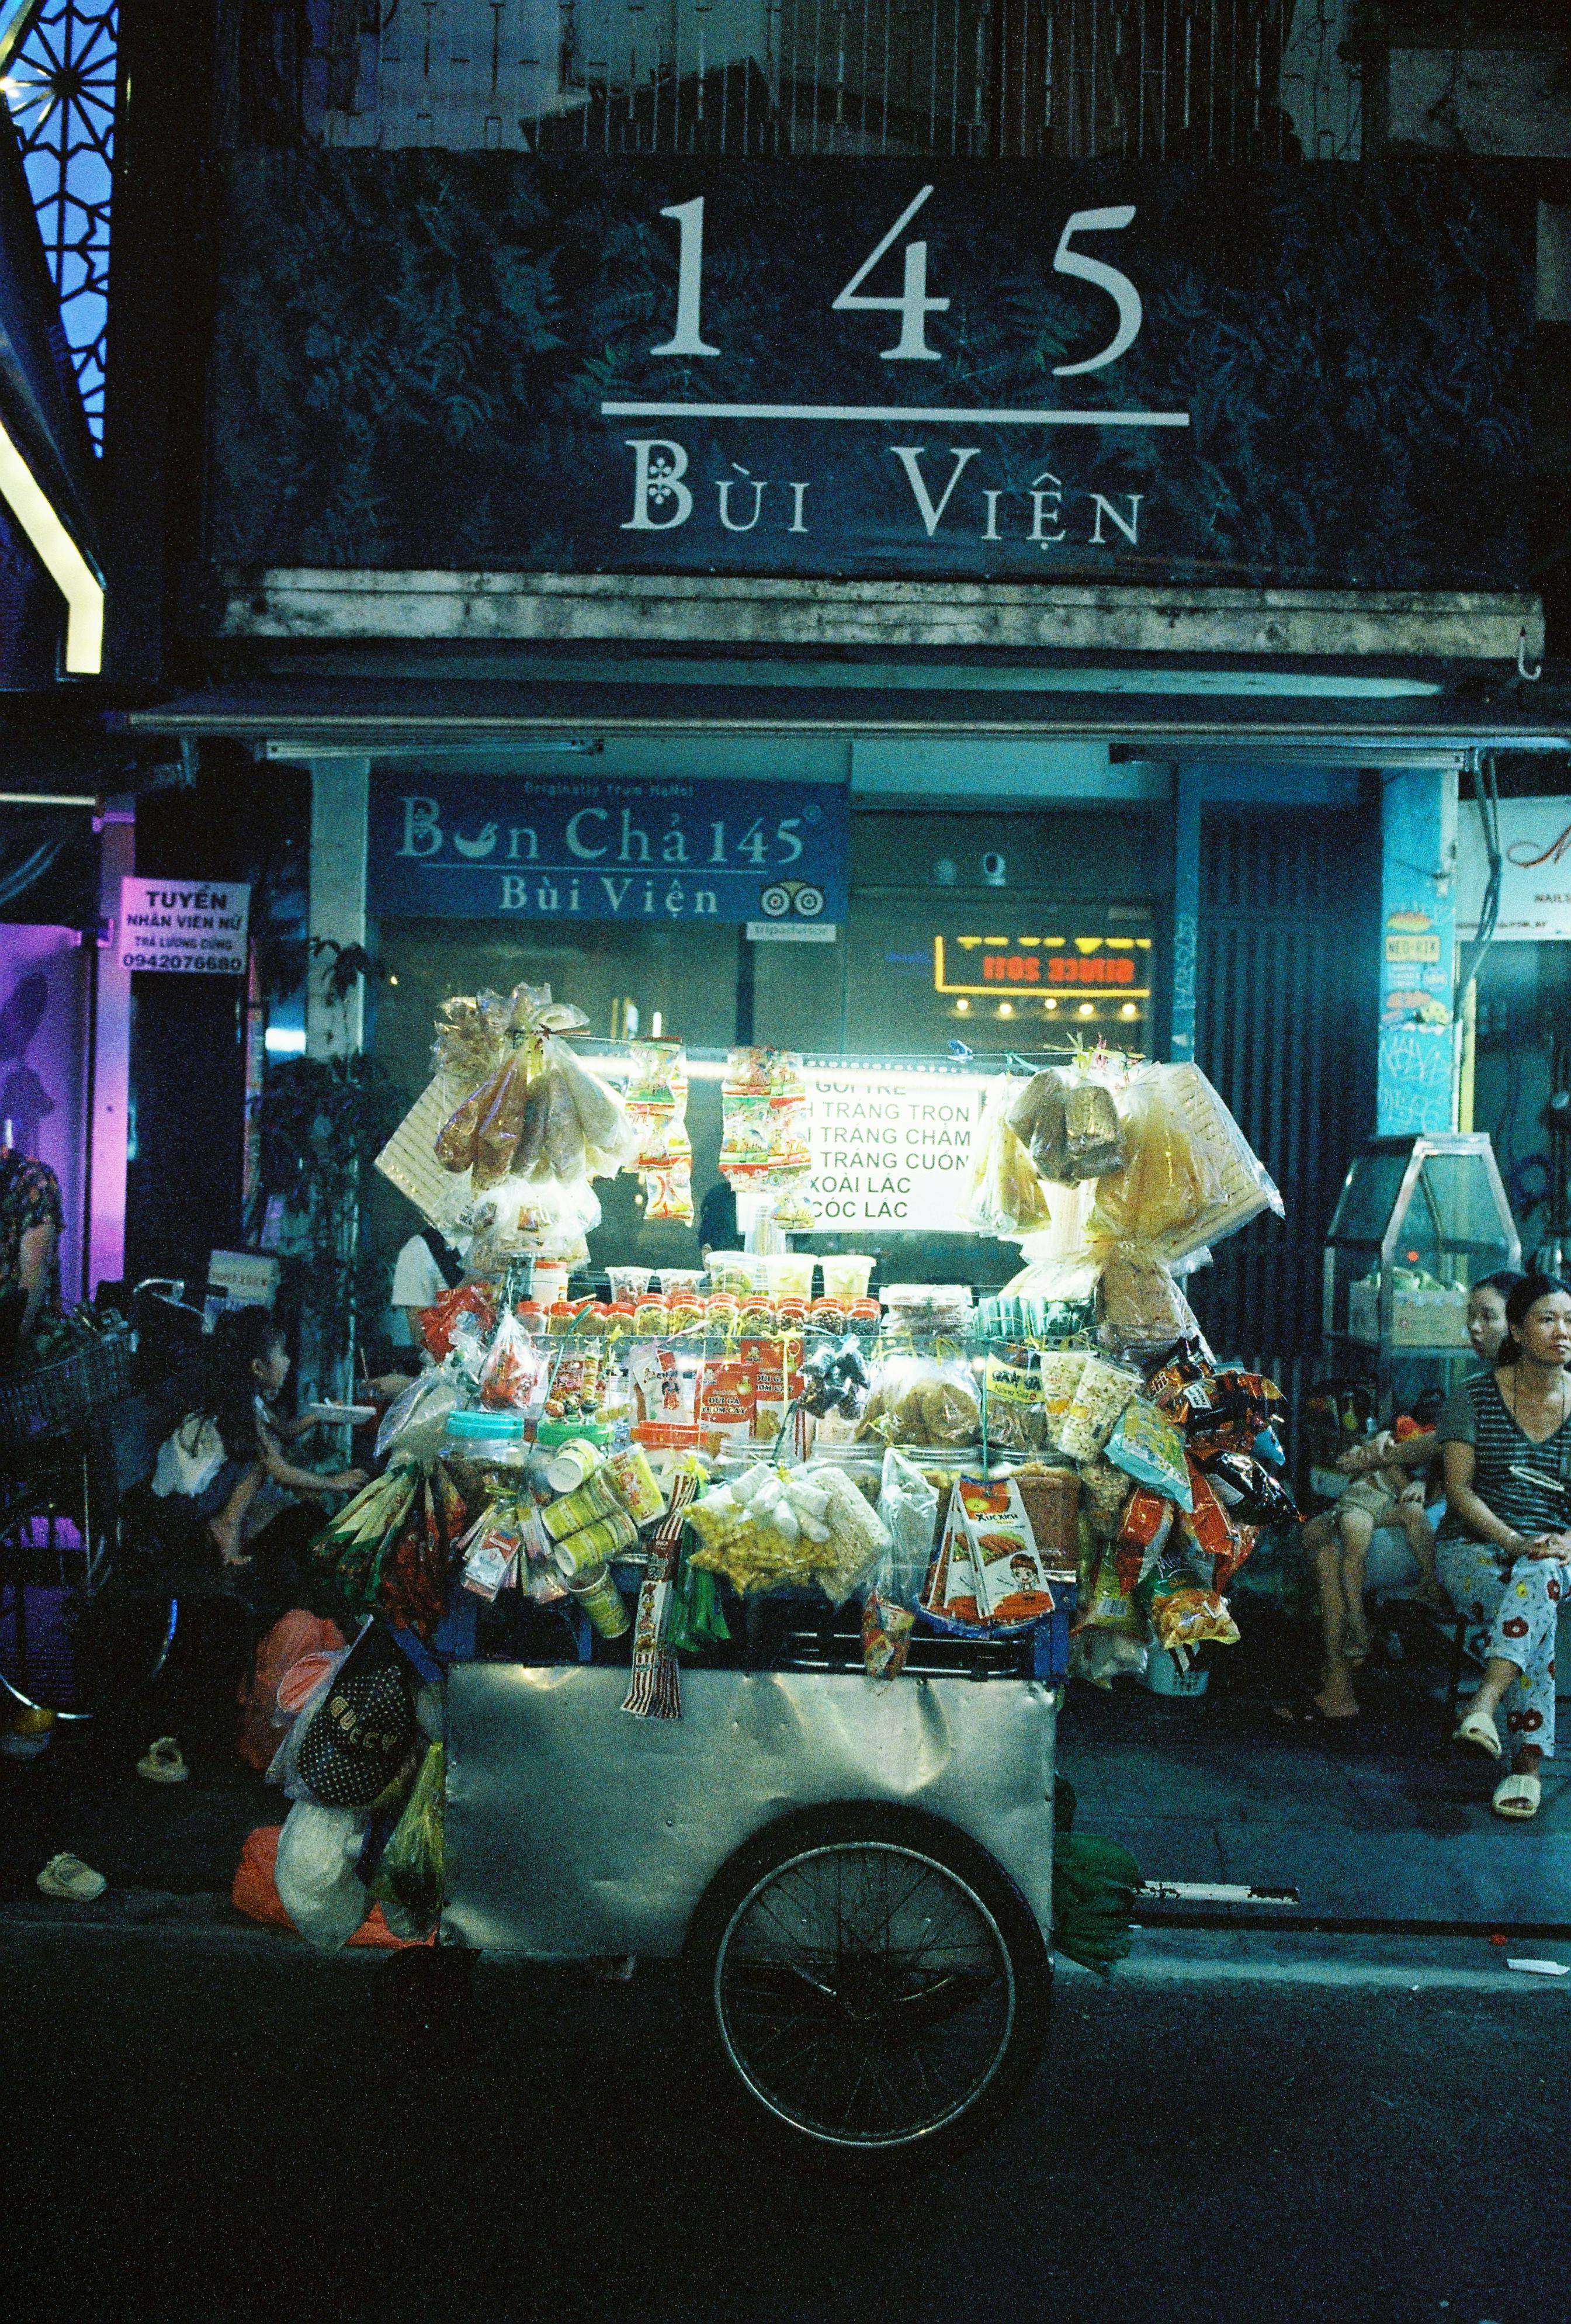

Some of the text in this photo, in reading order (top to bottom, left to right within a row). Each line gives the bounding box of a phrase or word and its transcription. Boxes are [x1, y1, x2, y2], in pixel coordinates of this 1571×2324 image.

[565, 808, 689, 863] Chả
[709, 818, 805, 864] 145
[498, 875, 719, 919] Bùi Viện
[820, 1123, 897, 1144] TRÁNG
[820, 1148, 897, 1168] TRÁNG
